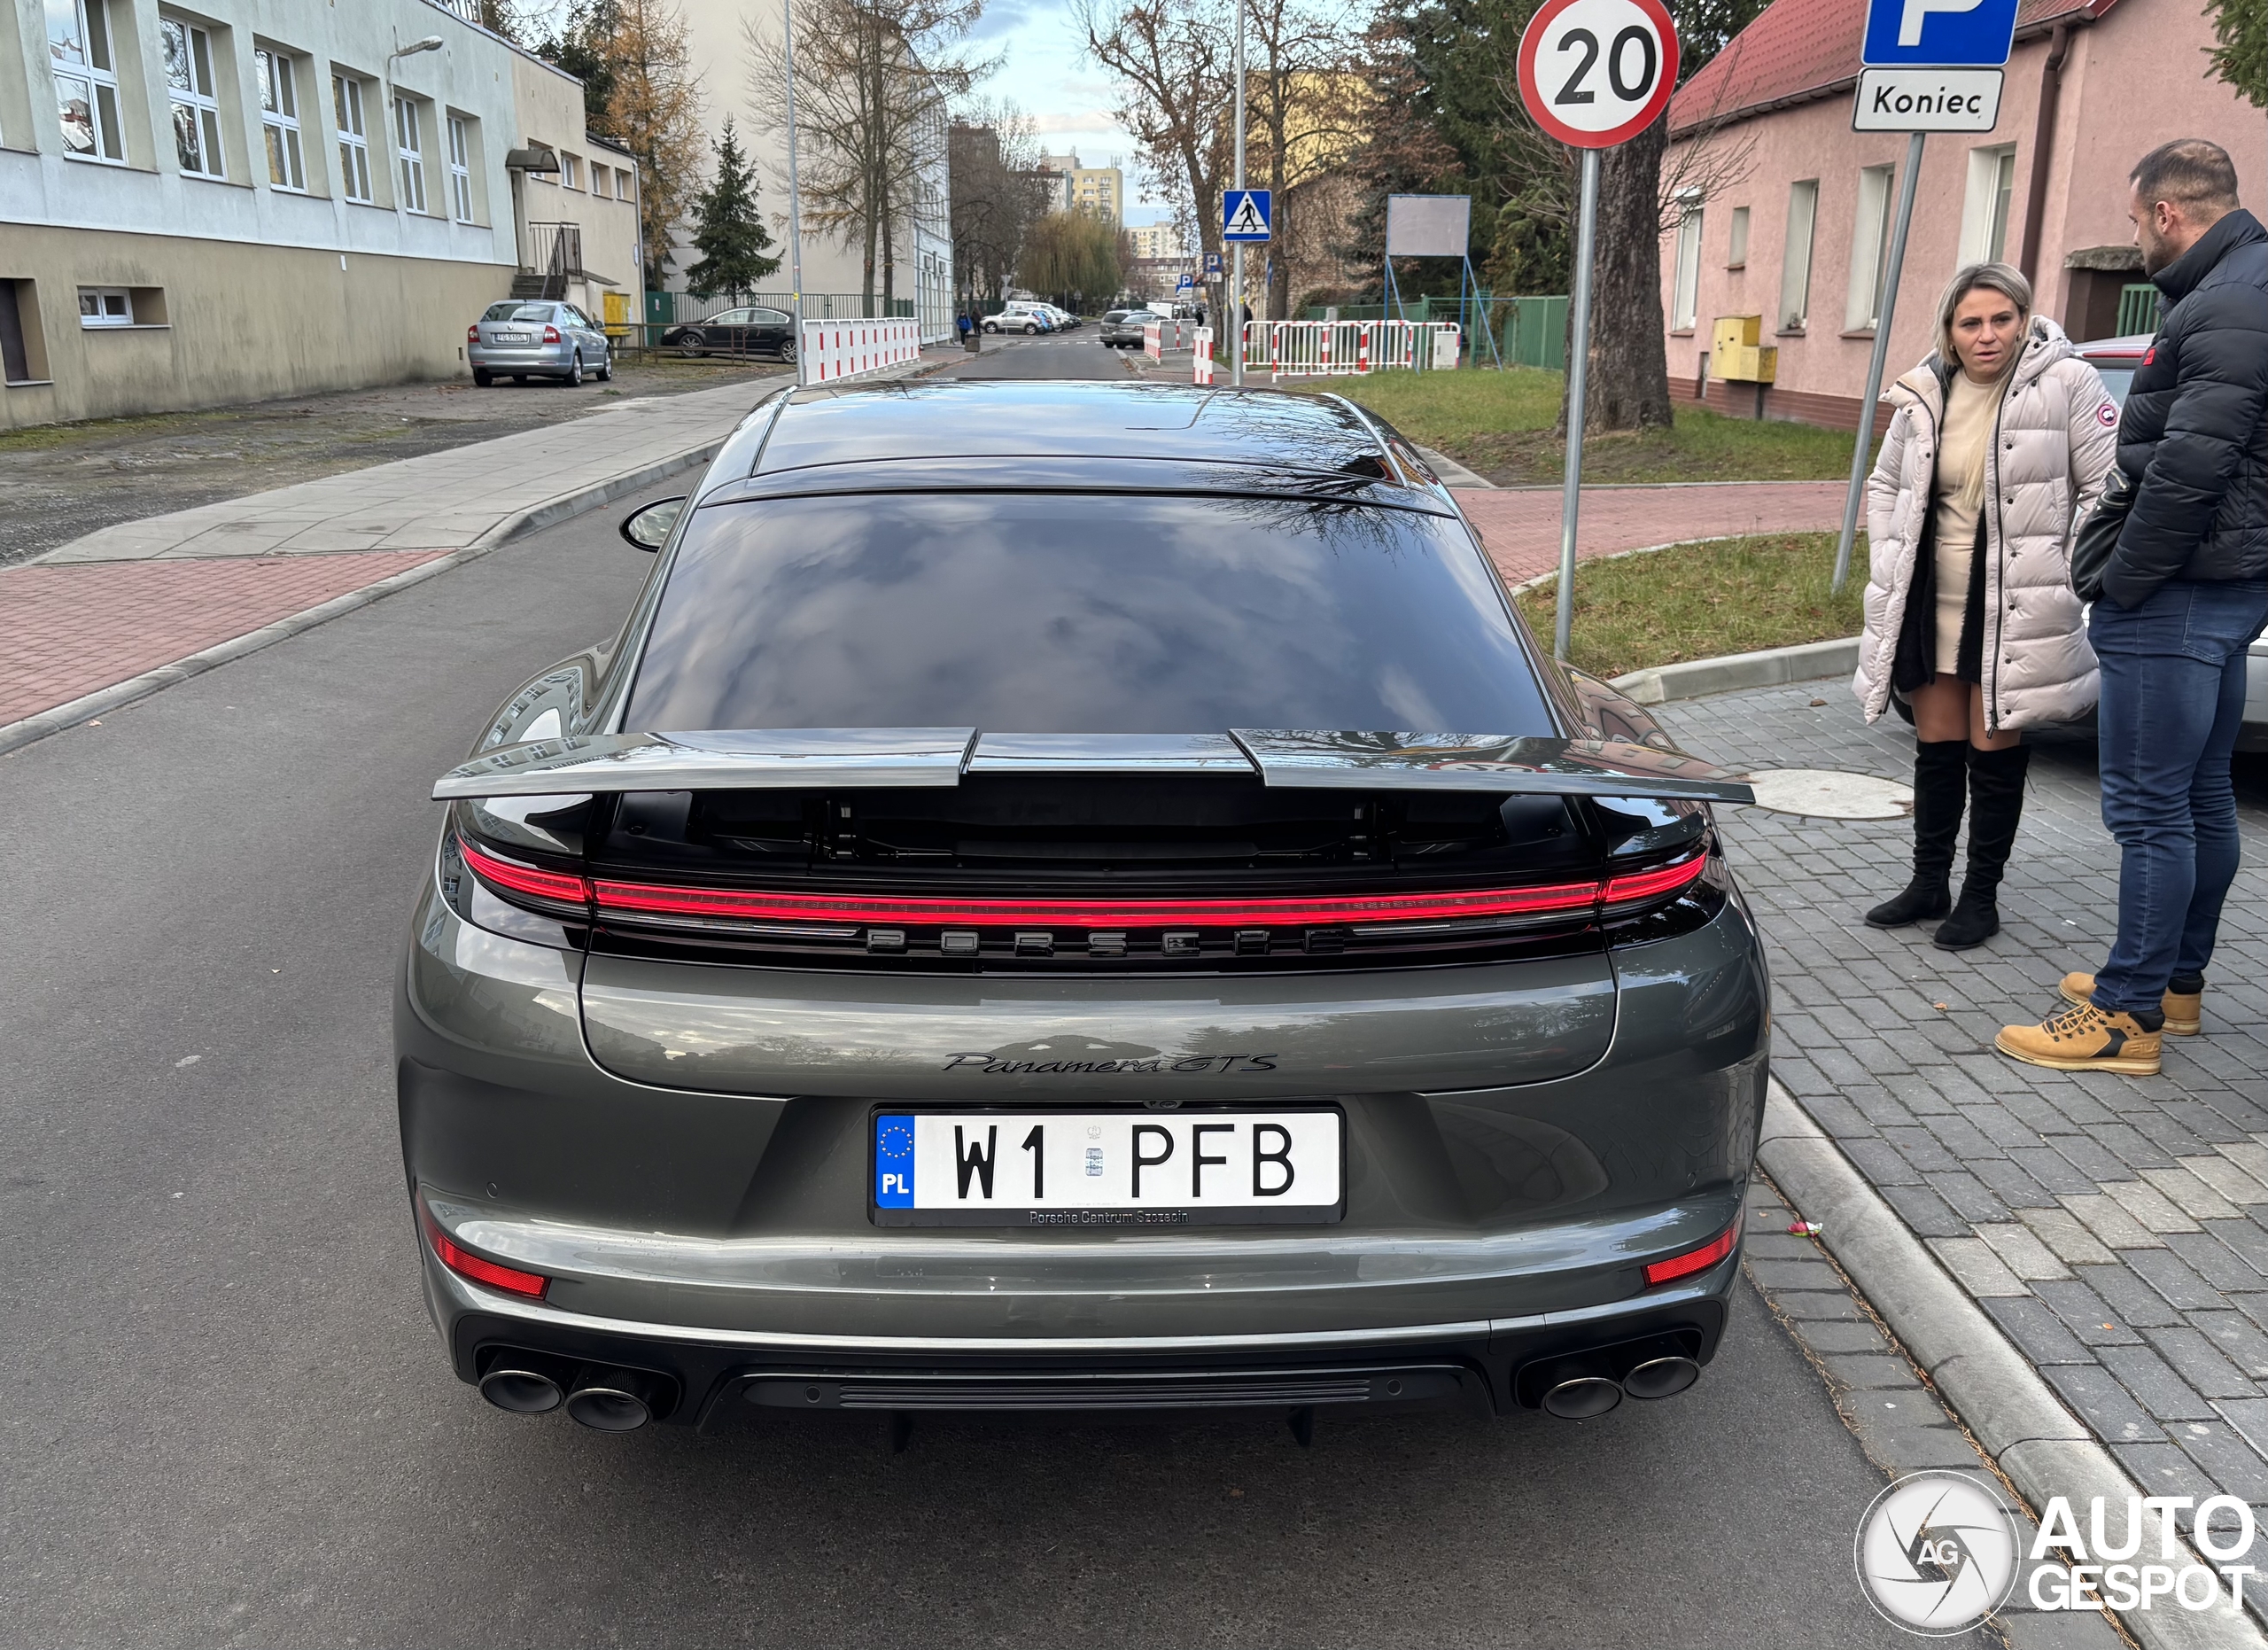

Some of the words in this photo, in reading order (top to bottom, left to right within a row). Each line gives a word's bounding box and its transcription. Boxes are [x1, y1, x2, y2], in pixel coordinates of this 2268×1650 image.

[1555, 25, 1657, 105] 20
[1873, 85, 1982, 115] Koniec
[1182, 276, 1191, 286] P
[866, 928, 1344, 956] PORSCHE
[2129, 1042, 2159, 1055] FILA
[941, 1052, 1164, 1073] Panamera
[1169, 1053, 1278, 1073] GTS
[954, 1125, 1044, 1200] W1
[1131, 1124, 1295, 1199] PFB
[882, 1173, 909, 1195] PL
[1029, 1211, 1078, 1224] Porsche
[1081, 1210, 1133, 1224] Centrum
[1137, 1210, 1189, 1223] Szczecin
